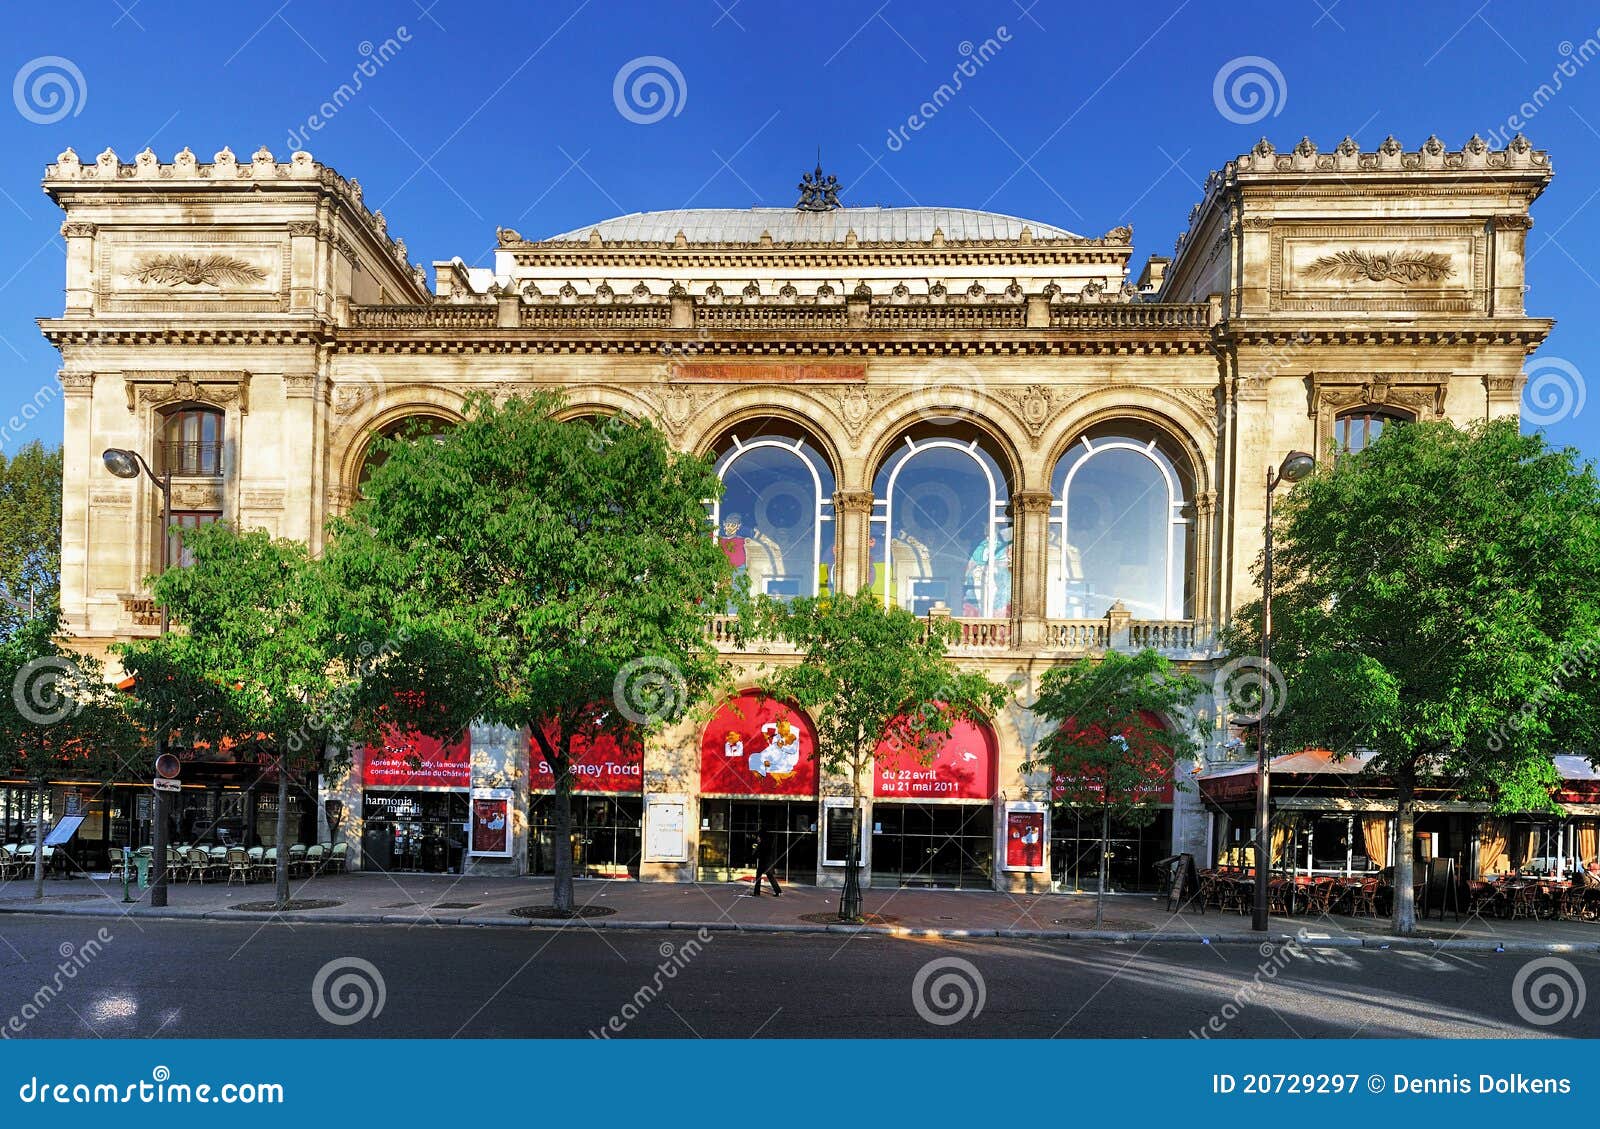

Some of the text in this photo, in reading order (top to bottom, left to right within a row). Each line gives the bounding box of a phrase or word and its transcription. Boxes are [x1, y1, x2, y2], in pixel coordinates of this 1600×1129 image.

[539, 761, 603, 777] Seney
[882, 770, 936, 779] du 22 avril
[882, 782, 959, 791] au 21 mai 2011
[365, 794, 412, 806] harmonia
[387, 803, 420, 813] mundi
